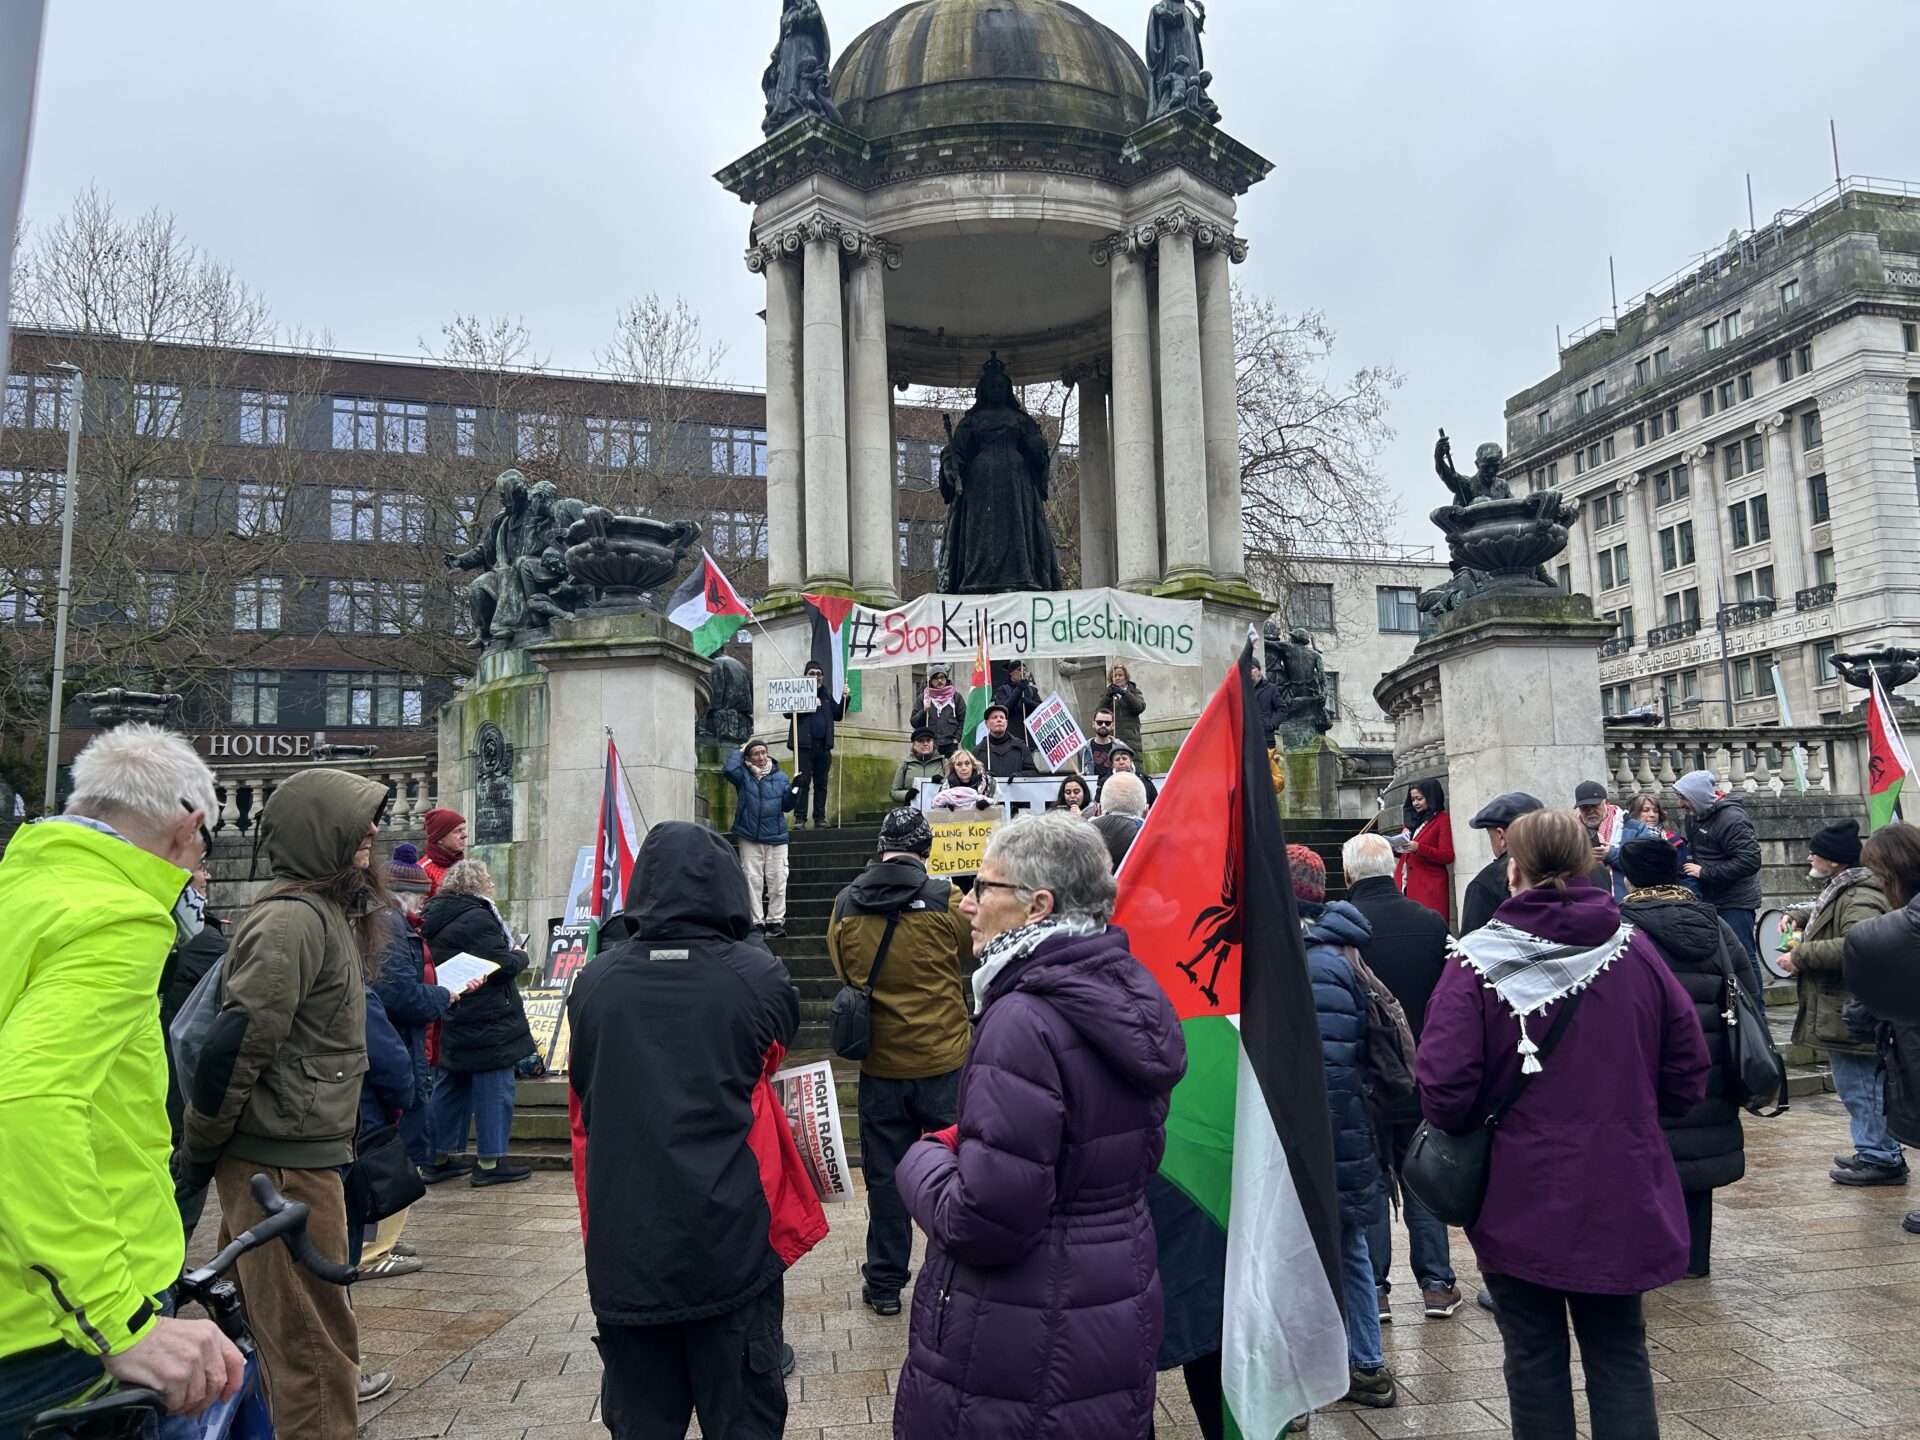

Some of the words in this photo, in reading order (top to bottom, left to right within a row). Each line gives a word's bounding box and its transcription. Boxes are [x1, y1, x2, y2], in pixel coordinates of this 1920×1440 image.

[769, 680, 815, 694] MARWAN
[1035, 717, 1058, 743] DEFEND
[1054, 709, 1068, 726] THE
[1041, 709, 1052, 721] THE
[208, 734, 310, 756] HOUSE
[1040, 726, 1065, 755] RIGHT
[1060, 719, 1076, 736] TO
[1047, 731, 1082, 768] PROTEST
[943, 842, 952, 851] IS
[956, 840, 980, 851] NOT
[968, 826, 992, 837] KIDS
[931, 858, 955, 872] SELF
[957, 858, 982, 870] DEFE
[802, 1072, 814, 1108] FIGHT
[813, 1070, 830, 1118] FIGHT
[805, 1111, 834, 1195] IMPERIALISM!
[818, 1121, 845, 1194] RACISM!
